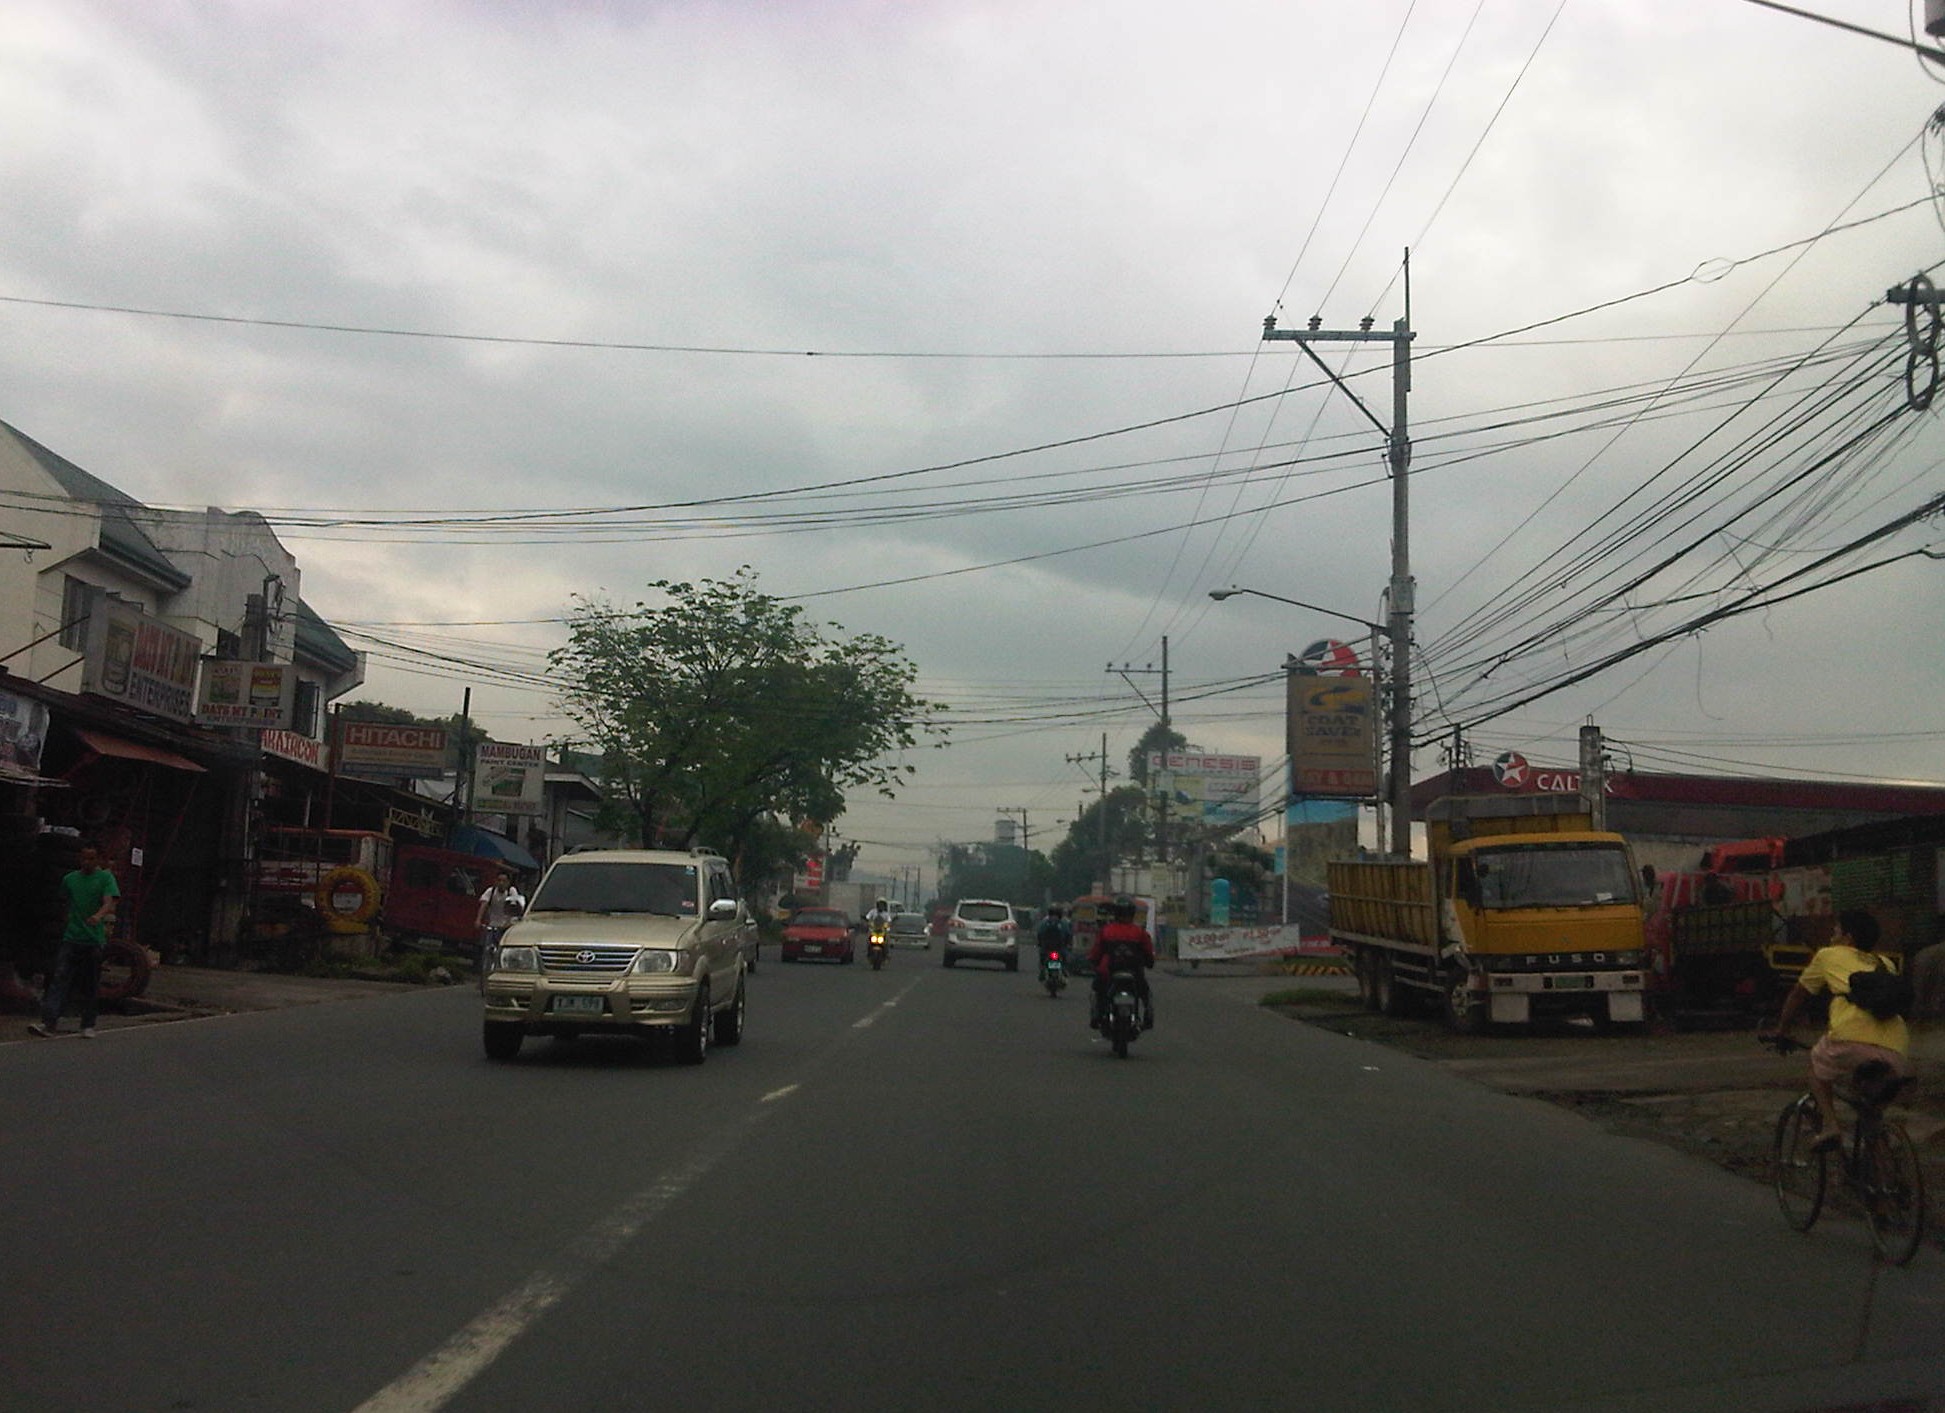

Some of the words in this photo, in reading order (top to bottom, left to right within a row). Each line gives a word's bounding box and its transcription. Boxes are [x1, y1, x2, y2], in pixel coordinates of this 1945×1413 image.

[350, 727, 442, 749] HITACHI
[481, 745, 541, 761] MAMBUGAN
[1152, 755, 1256, 771] GENESIS
[1537, 774, 1614, 794] CALX
[1526, 952, 1606, 965] FUSO
